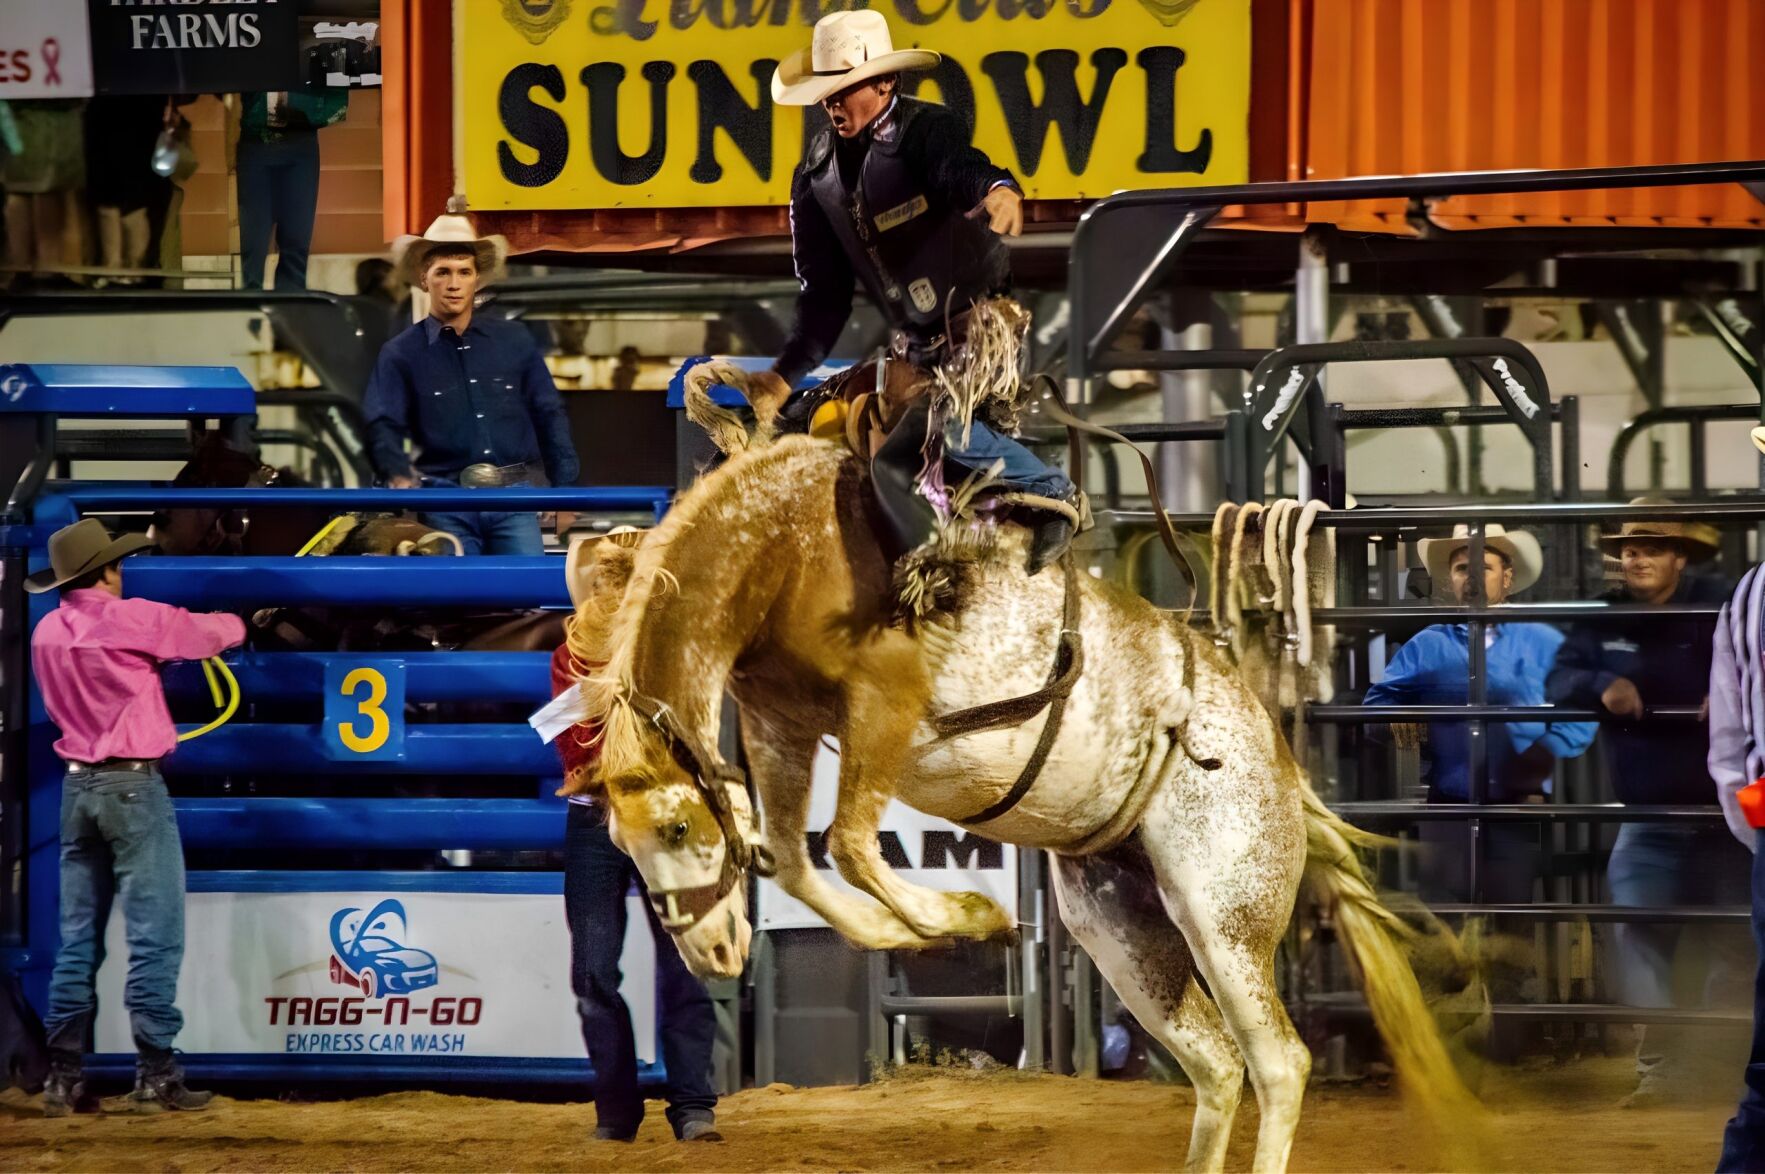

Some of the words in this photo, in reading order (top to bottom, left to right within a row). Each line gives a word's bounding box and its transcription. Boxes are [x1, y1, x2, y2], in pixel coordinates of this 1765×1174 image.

[130, 13, 261, 49] FARMS
[338, 667, 390, 753] 3
[286, 1033, 364, 1053] EXPRESS
[369, 1033, 405, 1053] CAR
[411, 1033, 465, 1053] WASH
